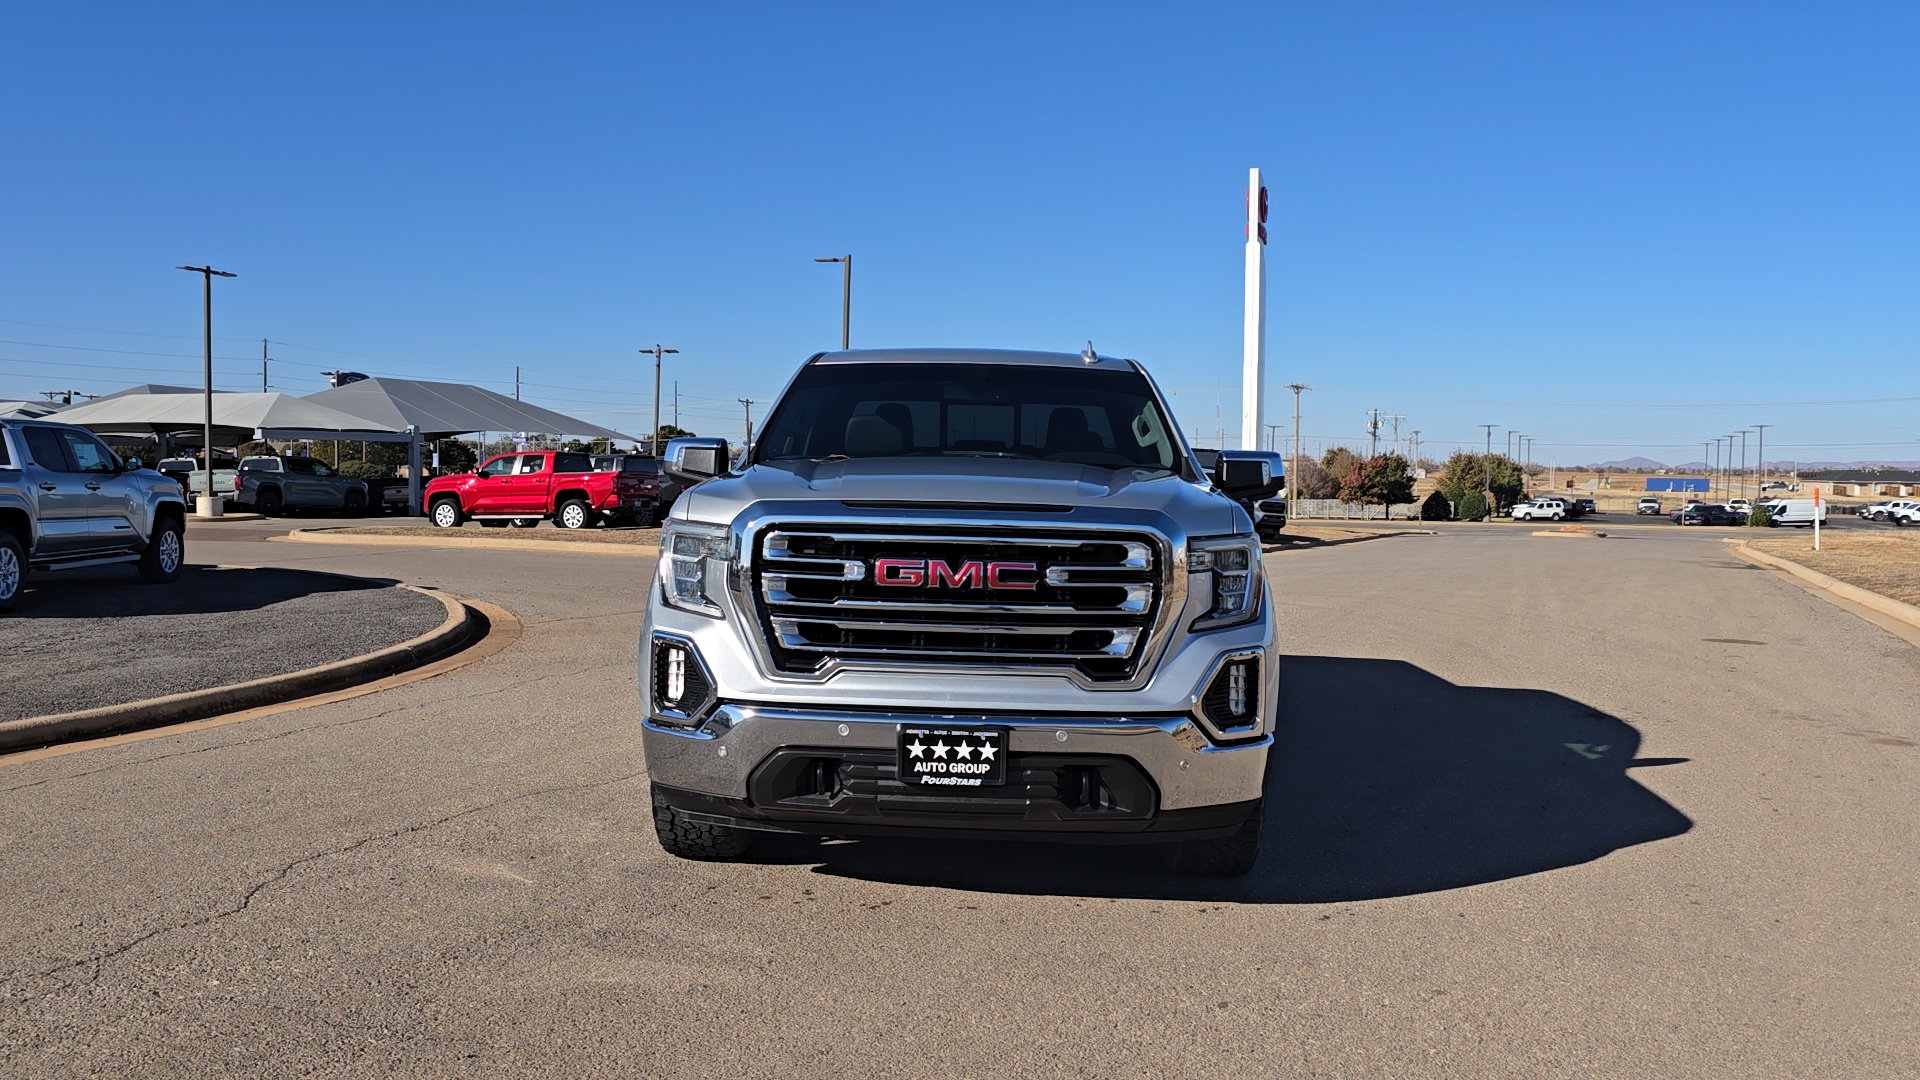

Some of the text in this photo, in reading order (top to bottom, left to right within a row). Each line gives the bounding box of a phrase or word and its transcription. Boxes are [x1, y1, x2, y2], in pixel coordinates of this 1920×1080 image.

[875, 558, 1038, 590] GMC
[914, 762, 991, 774] AUTO GROUP
